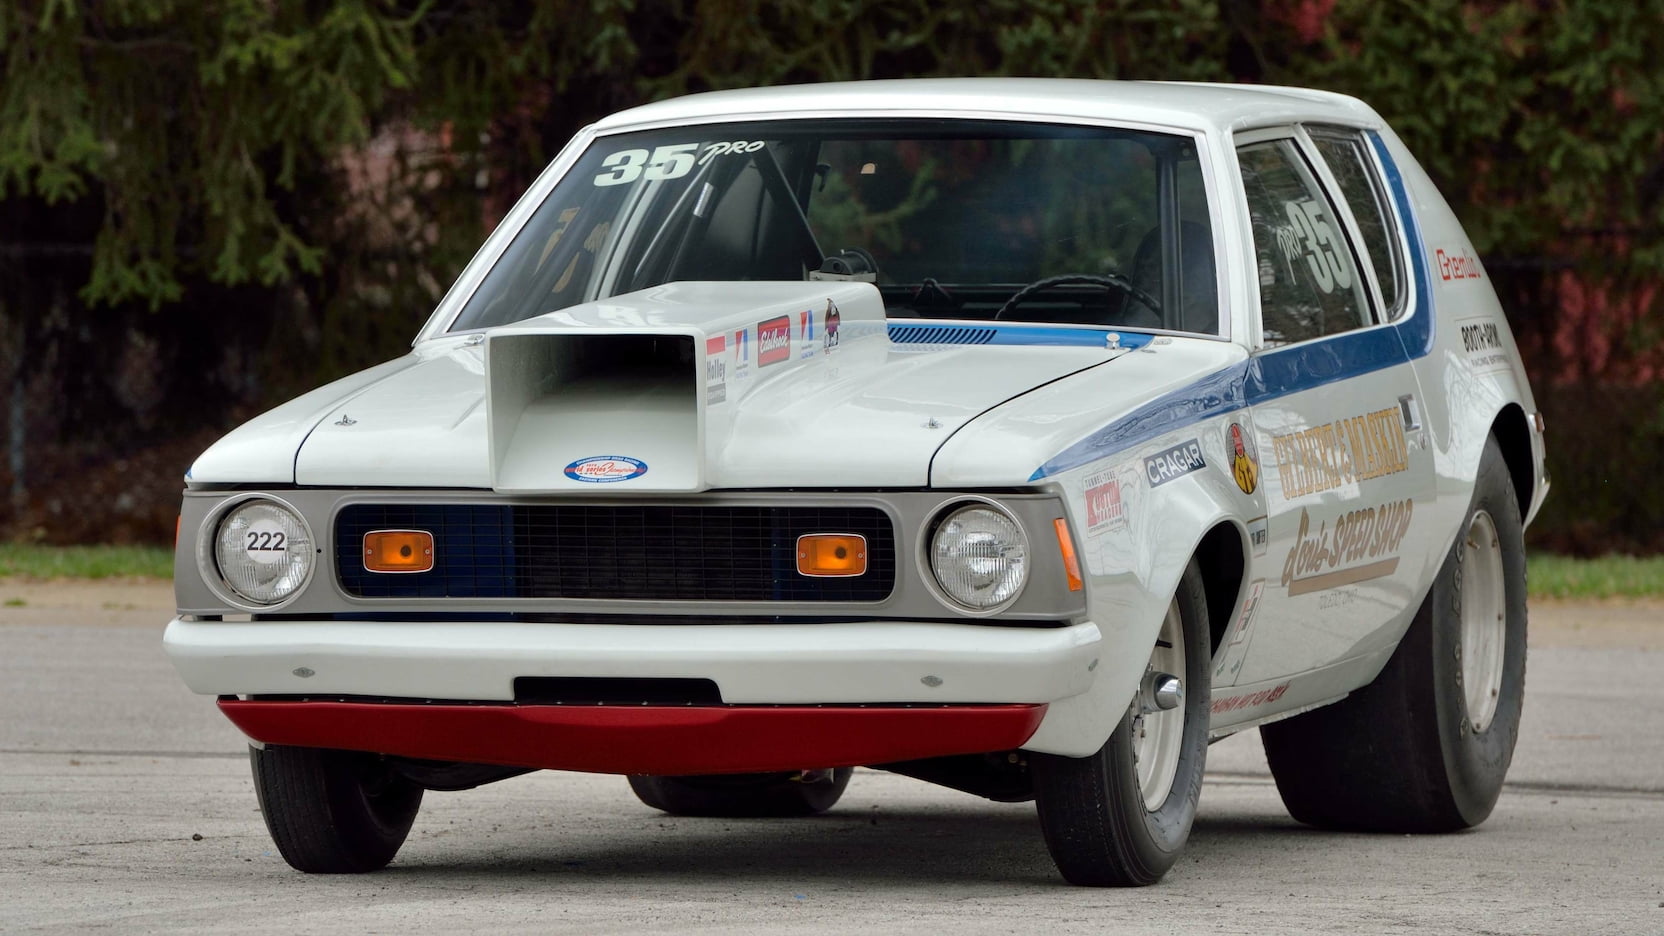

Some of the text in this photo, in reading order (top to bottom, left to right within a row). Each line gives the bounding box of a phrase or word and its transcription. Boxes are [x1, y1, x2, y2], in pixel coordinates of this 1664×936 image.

[593, 141, 765, 187] 35 PRO
[1286, 201, 1351, 294] 35
[760, 327, 790, 354] Edelbrock
[706, 359, 726, 381] Holley
[1147, 443, 1203, 484] CRAGAR
[247, 531, 286, 551] 222
[1328, 506, 1376, 569] SPEED
[1369, 498, 1414, 558] SHOP
